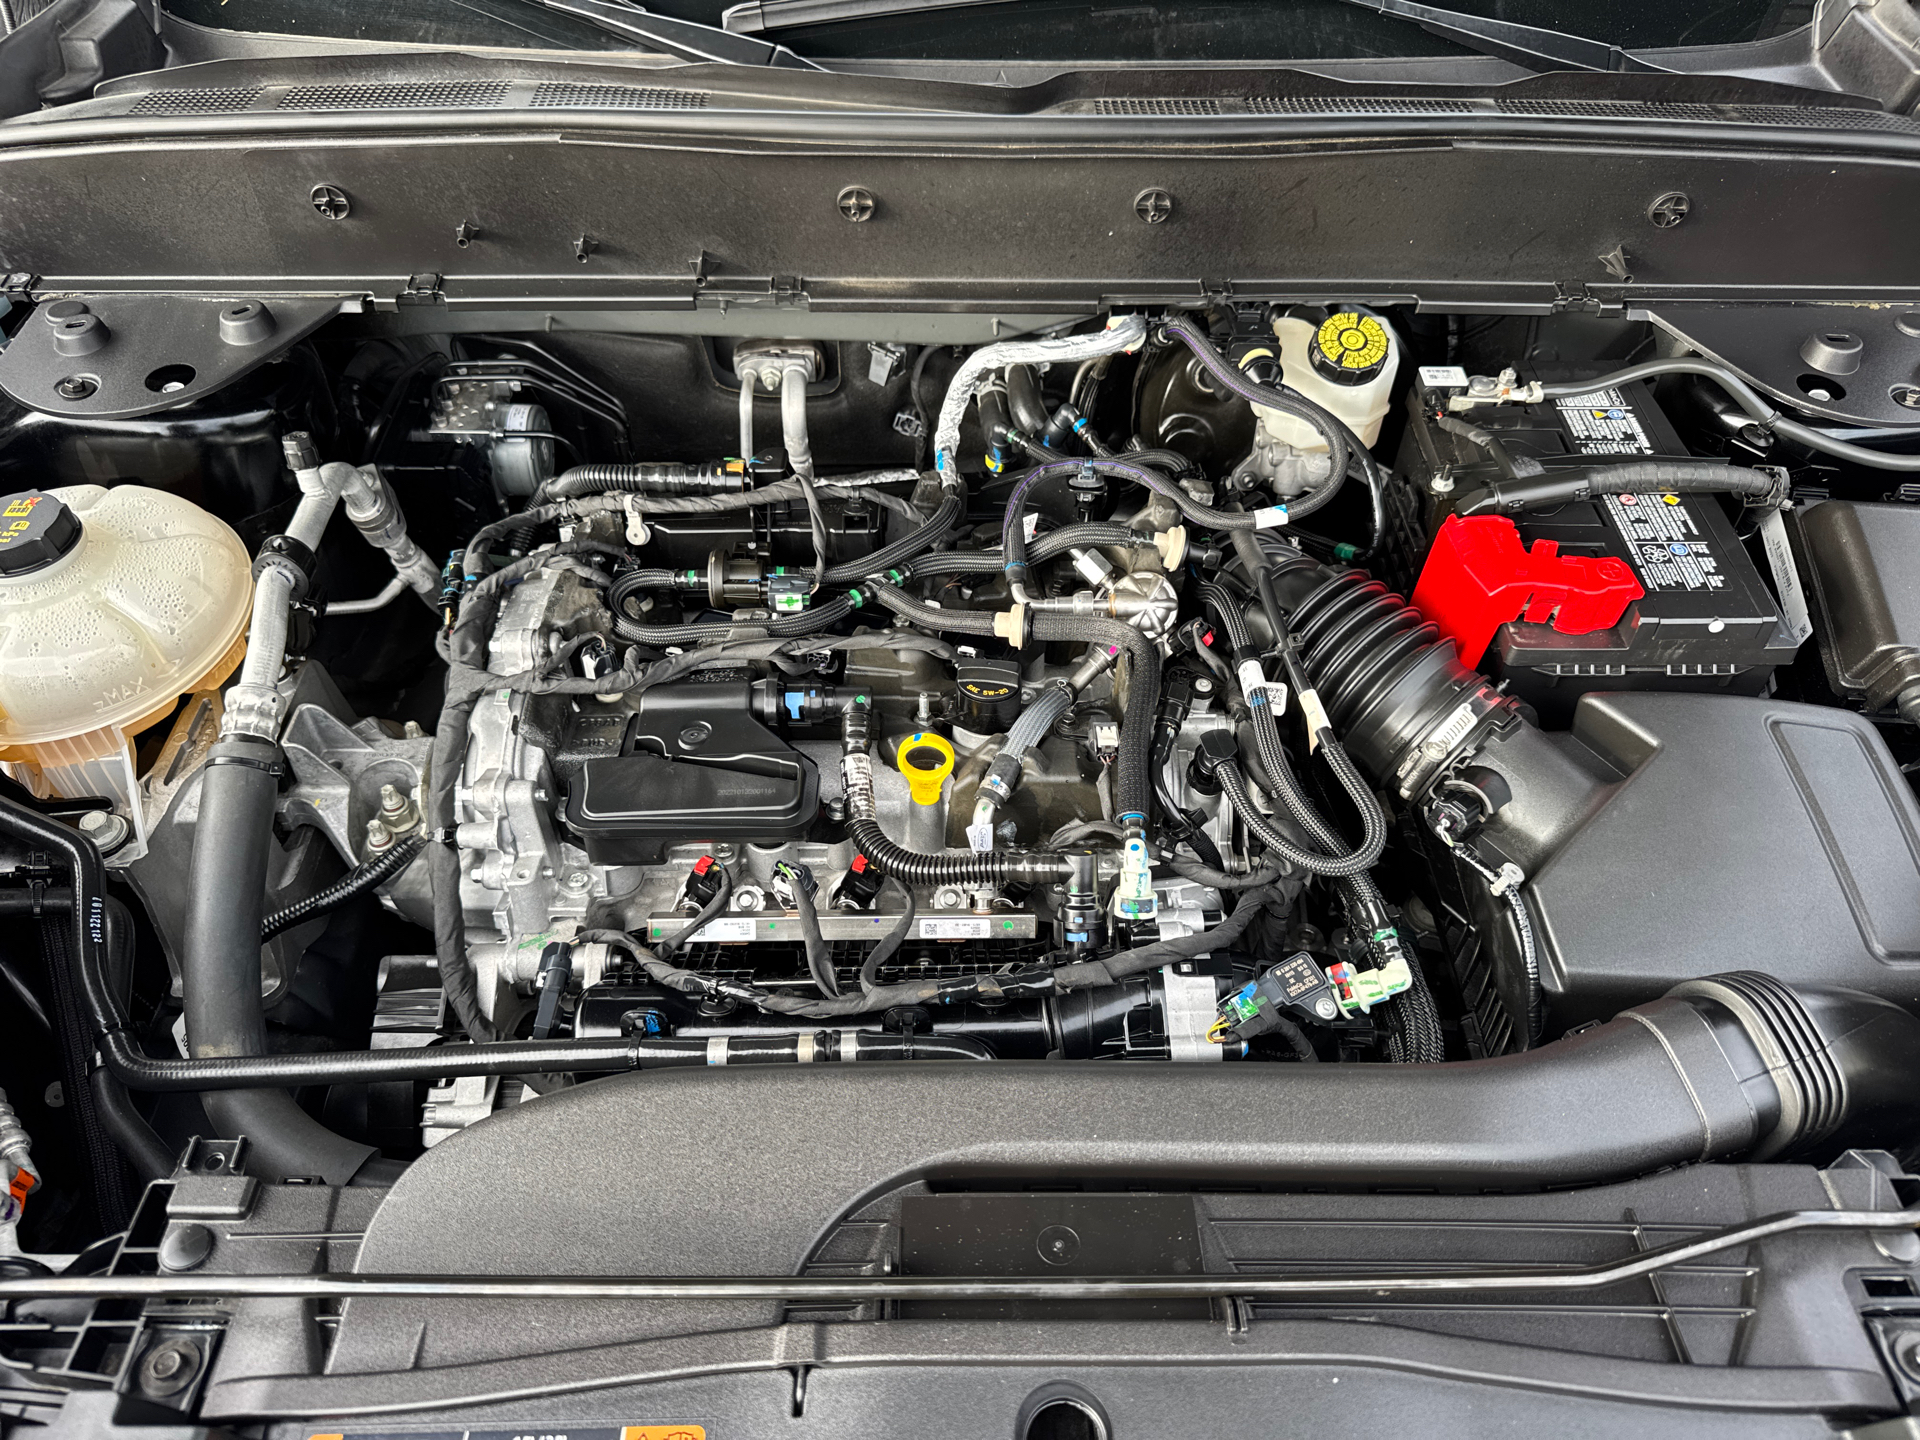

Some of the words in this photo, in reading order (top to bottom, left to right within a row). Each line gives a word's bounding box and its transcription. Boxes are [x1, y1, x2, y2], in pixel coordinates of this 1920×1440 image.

[103, 676, 152, 706] MAX
[966, 684, 981, 694] SAE
[983, 687, 1009, 696] 5W-20
